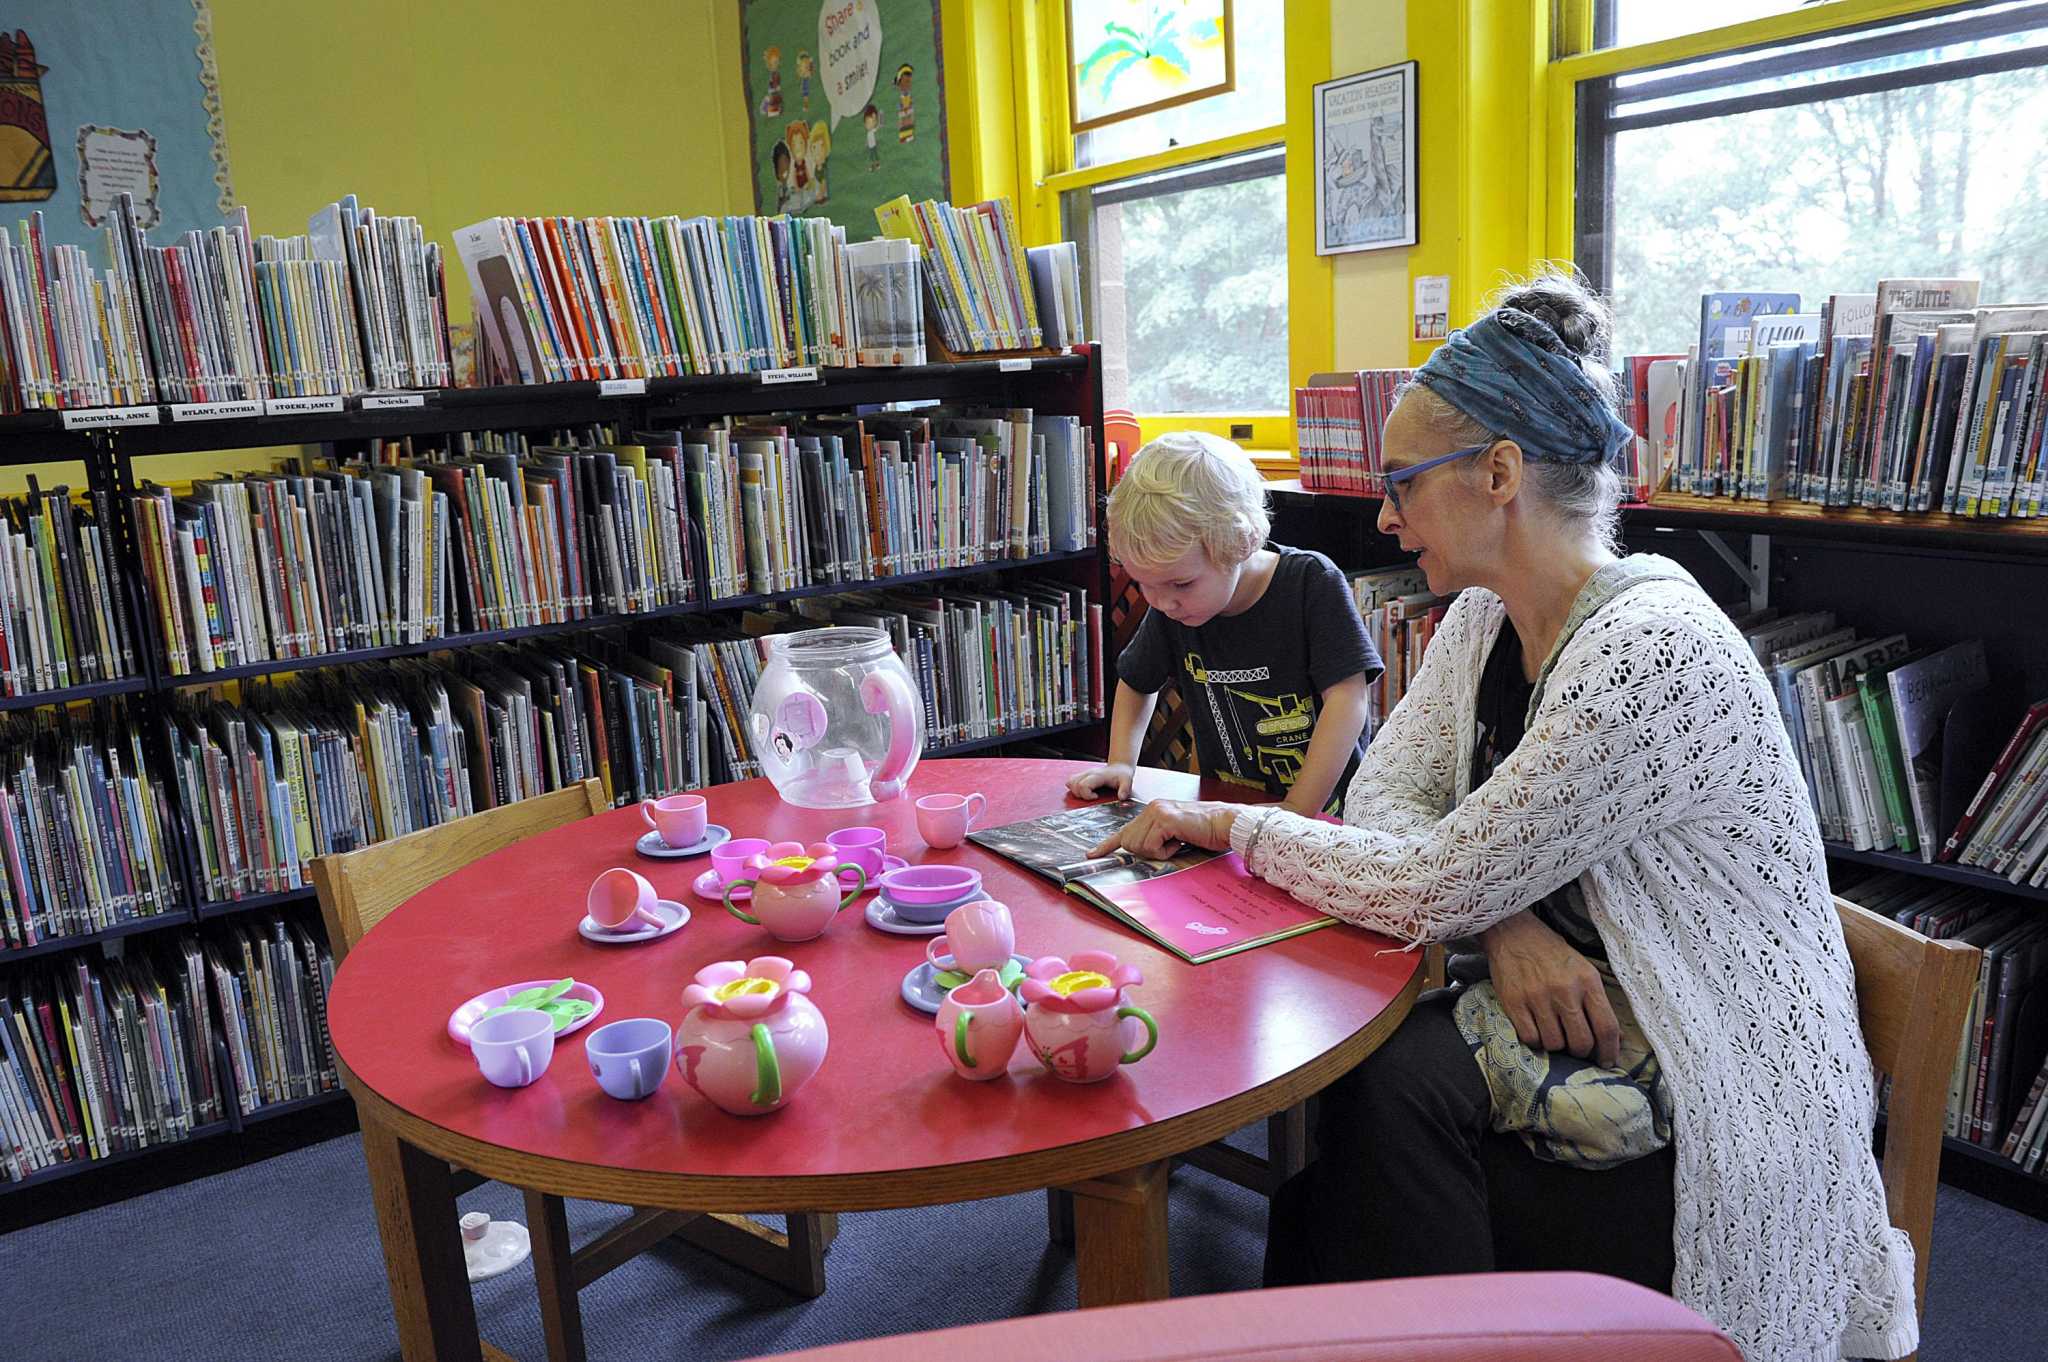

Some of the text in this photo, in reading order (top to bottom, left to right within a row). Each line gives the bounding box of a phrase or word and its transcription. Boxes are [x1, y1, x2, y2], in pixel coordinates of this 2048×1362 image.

[825, 2, 853, 36] Share
[829, 23, 869, 67] book and
[1915, 289, 1950, 307] LITTLE
[182, 405, 256, 417] RYLANT, CYNTHIA
[311, 402, 334, 410] JANET
[71, 414, 124, 423] ROCKWELL,
[1276, 732, 1309, 744] CRANE
